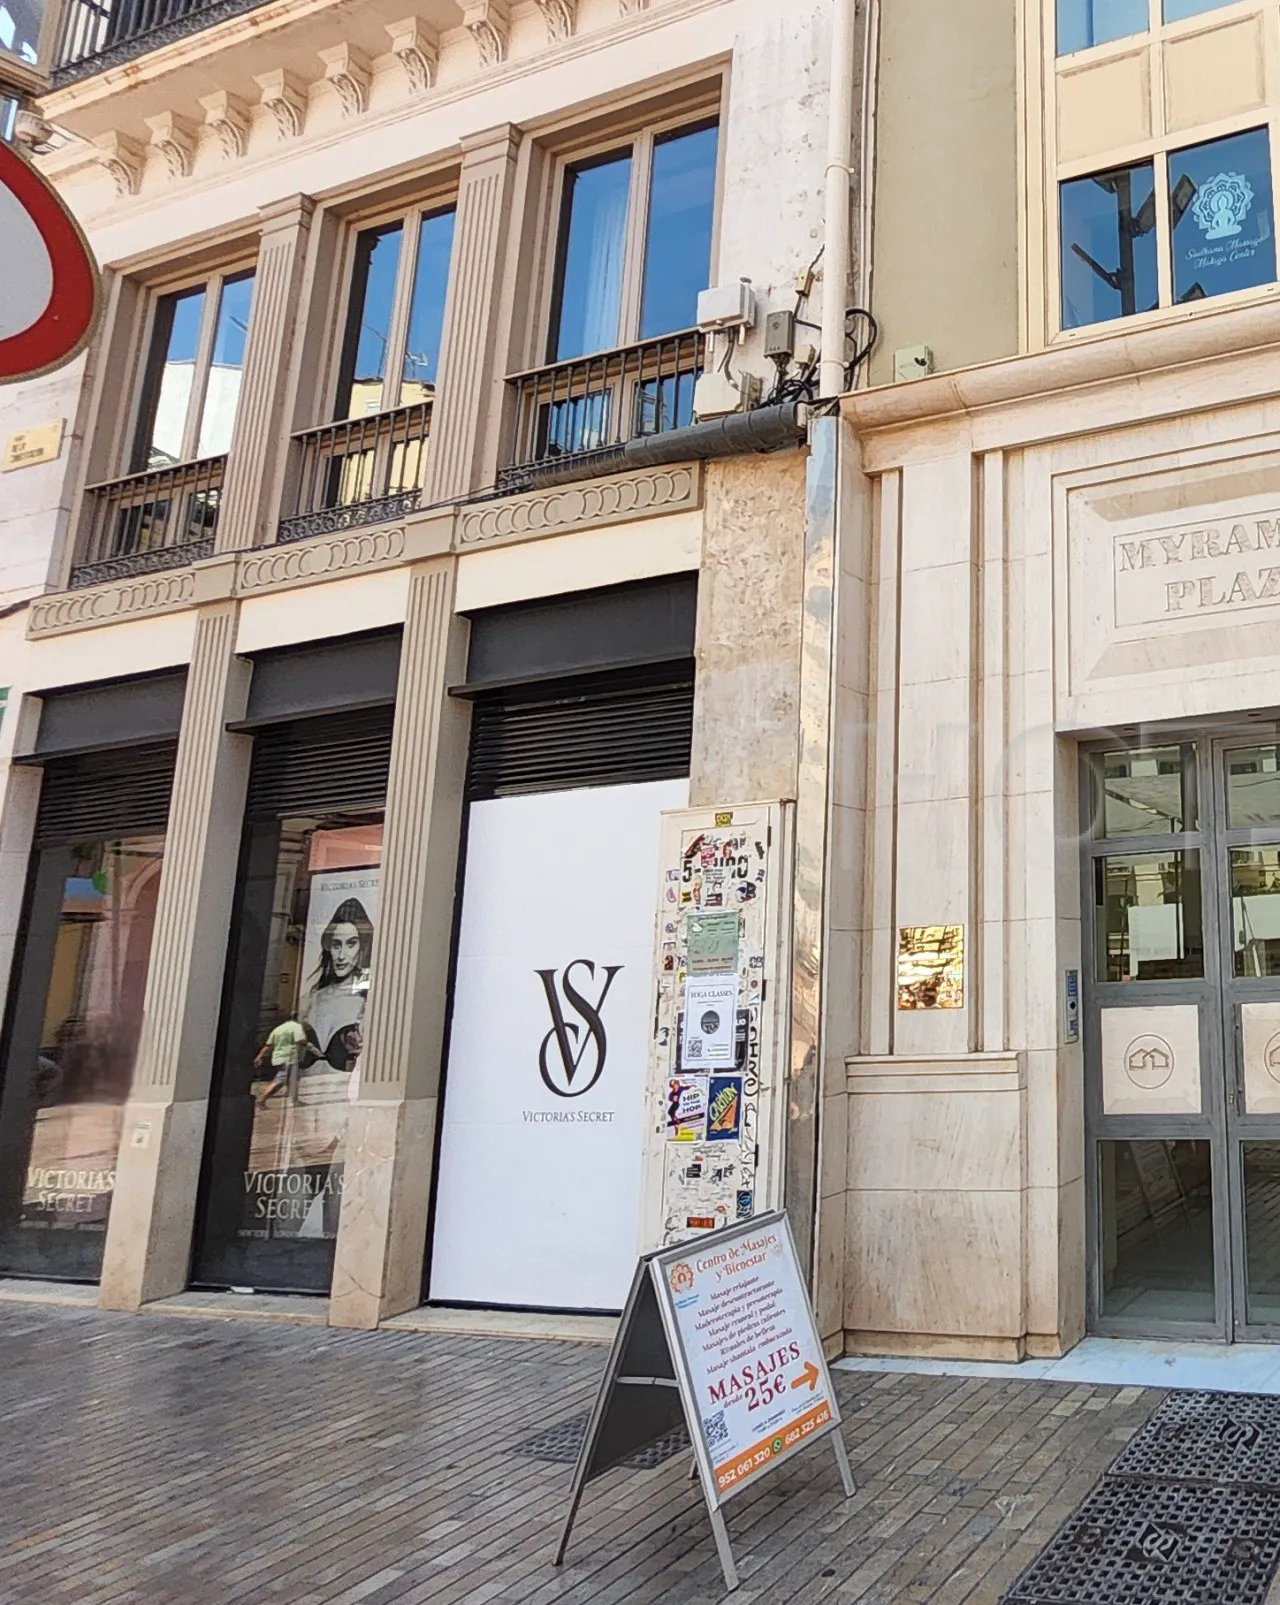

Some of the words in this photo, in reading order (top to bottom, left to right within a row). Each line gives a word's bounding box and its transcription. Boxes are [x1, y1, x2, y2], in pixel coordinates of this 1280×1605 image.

[359, 879, 380, 888] SECRE
[682, 1094, 700, 1102] HIP
[523, 1111, 575, 1122] VICTORIA'S
[577, 1110, 615, 1122] SECRET
[682, 1105, 701, 1114] HOP
[28, 1167, 117, 1190] VICTORIA'S
[244, 1171, 345, 1195] VICTORIA'S
[36, 1191, 96, 1213] SECRET
[254, 1196, 326, 1219] SECRE
[697, 1254, 726, 1272] Centro
[729, 1248, 739, 1259] de
[740, 1236, 776, 1255] Masajes
[723, 1253, 766, 1275] Bienestar
[709, 1342, 800, 1404] MASAJES
[724, 1394, 742, 1408] desde
[745, 1374, 786, 1411] 25€
[718, 1470, 736, 1487] 952
